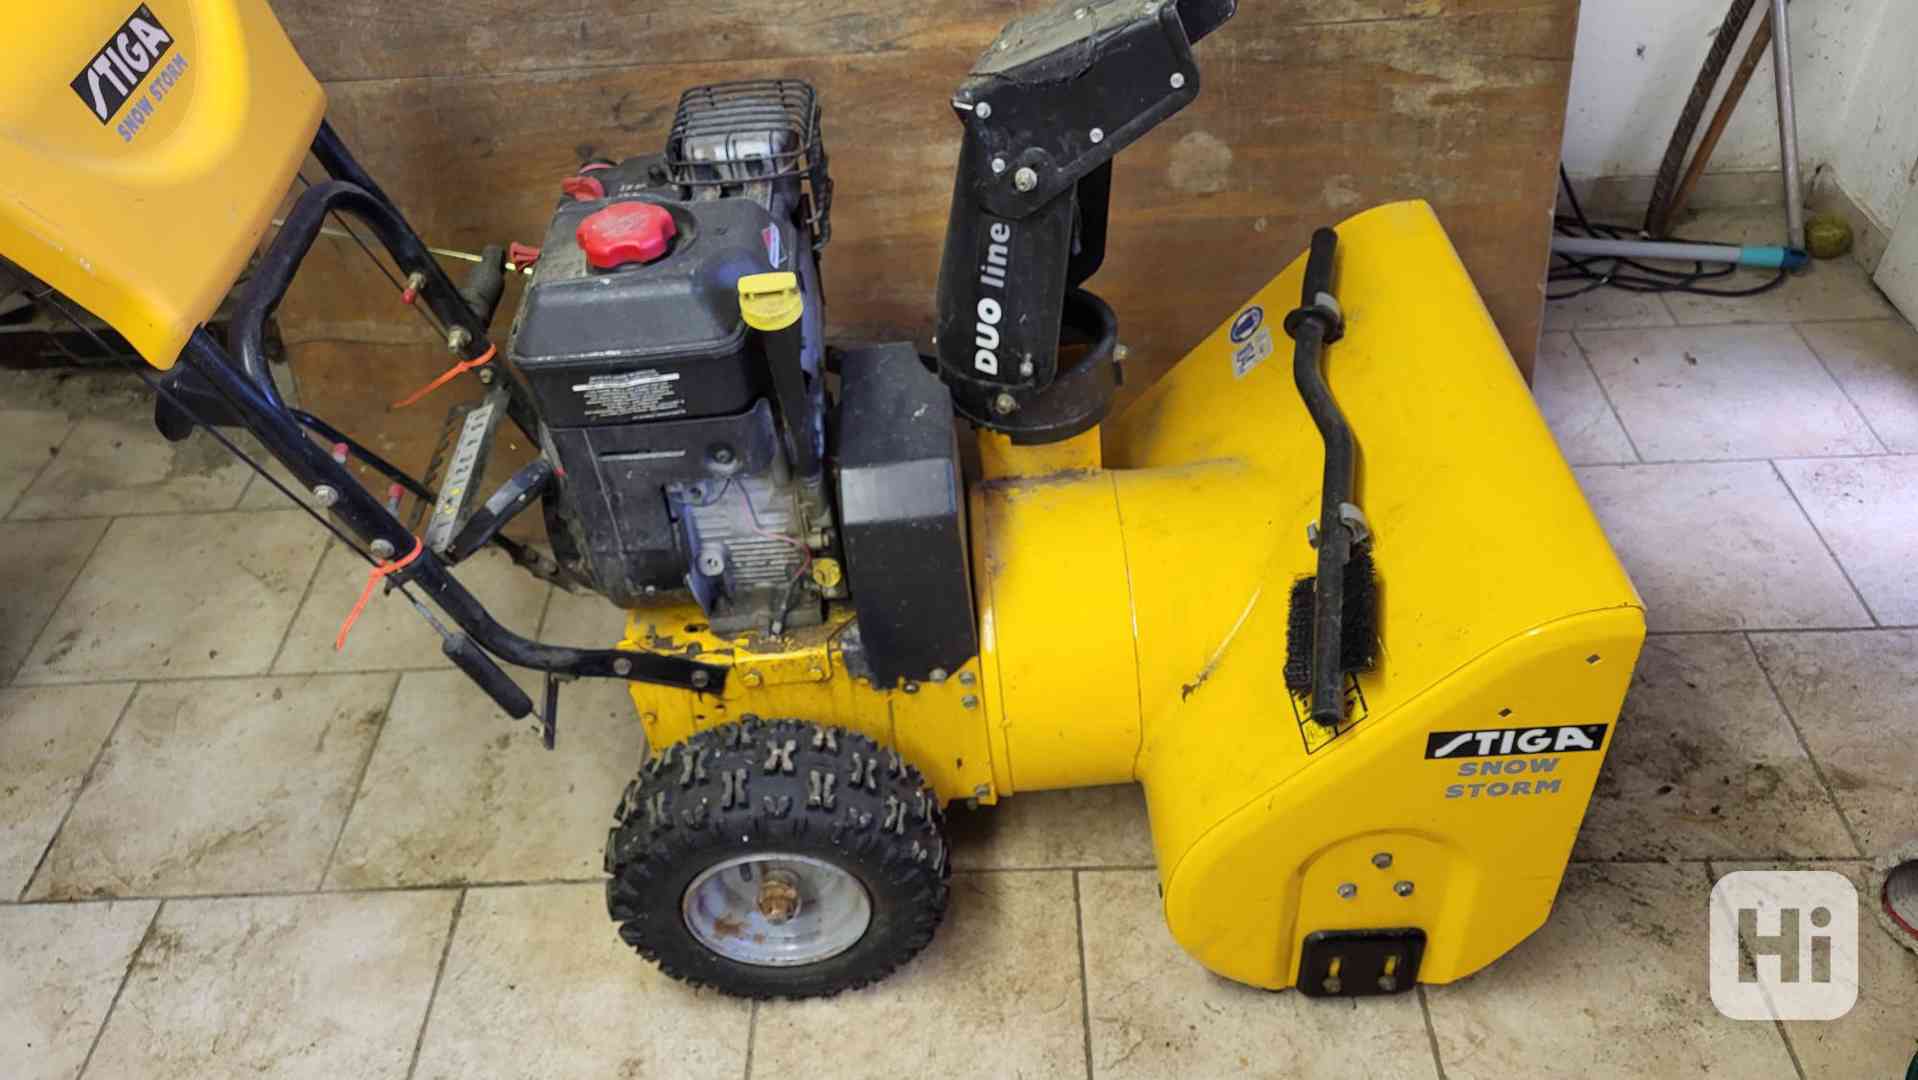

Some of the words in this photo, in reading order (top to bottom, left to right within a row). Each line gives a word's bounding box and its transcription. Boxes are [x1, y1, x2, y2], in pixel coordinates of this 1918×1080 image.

[87, 16, 171, 121] STIGA
[116, 95, 155, 142] SNOW
[149, 52, 189, 102] STORM
[980, 222, 1011, 288] line
[974, 297, 1002, 376] DUO
[1434, 727, 1594, 758] STIGA
[1457, 757, 1560, 777] SNOW
[1444, 779, 1562, 799] STORM
